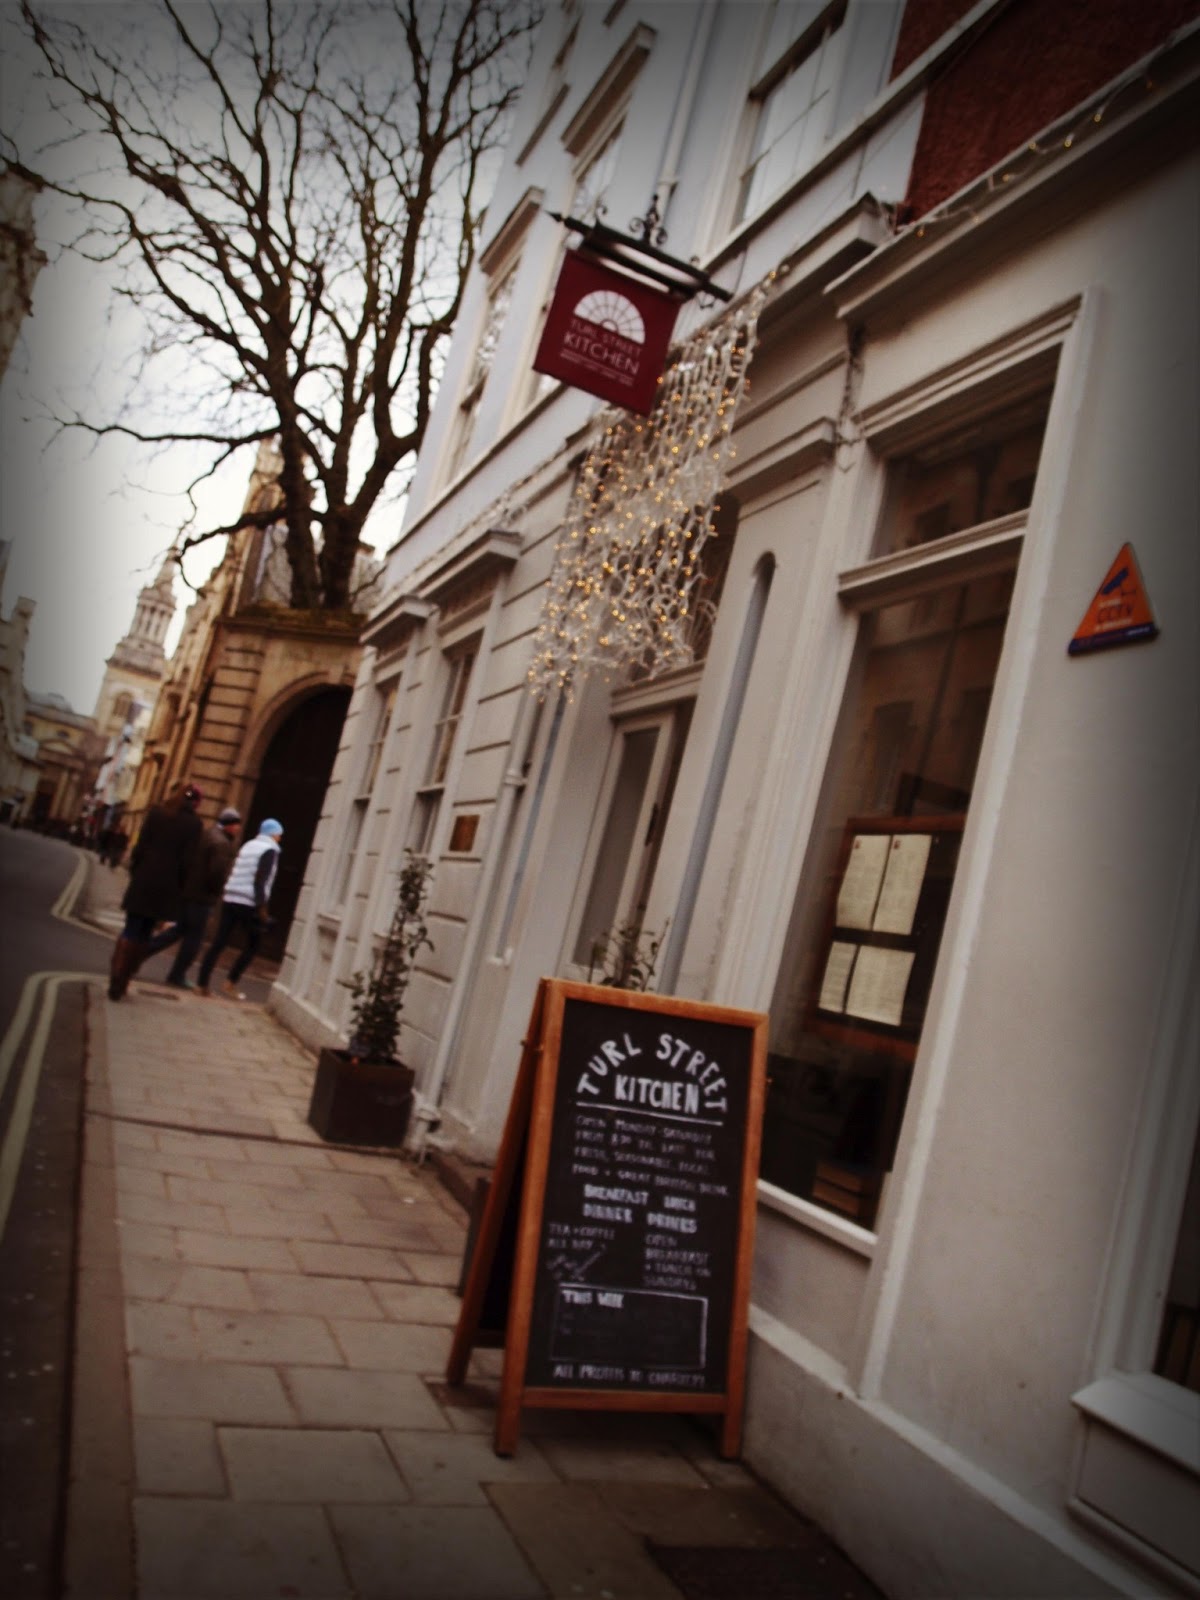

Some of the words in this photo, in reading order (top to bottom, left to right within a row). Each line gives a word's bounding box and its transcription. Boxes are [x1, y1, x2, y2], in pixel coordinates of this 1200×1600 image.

[564, 331, 640, 375] KITCHEN
[576, 1032, 642, 1095] TURL
[656, 1033, 728, 1113] STREET
[615, 1074, 699, 1114] KITCHEN
[584, 1184, 649, 1205] BREAKFAST
[583, 1203, 633, 1223] DINNER
[647, 1212, 697, 1234] DRINKS
